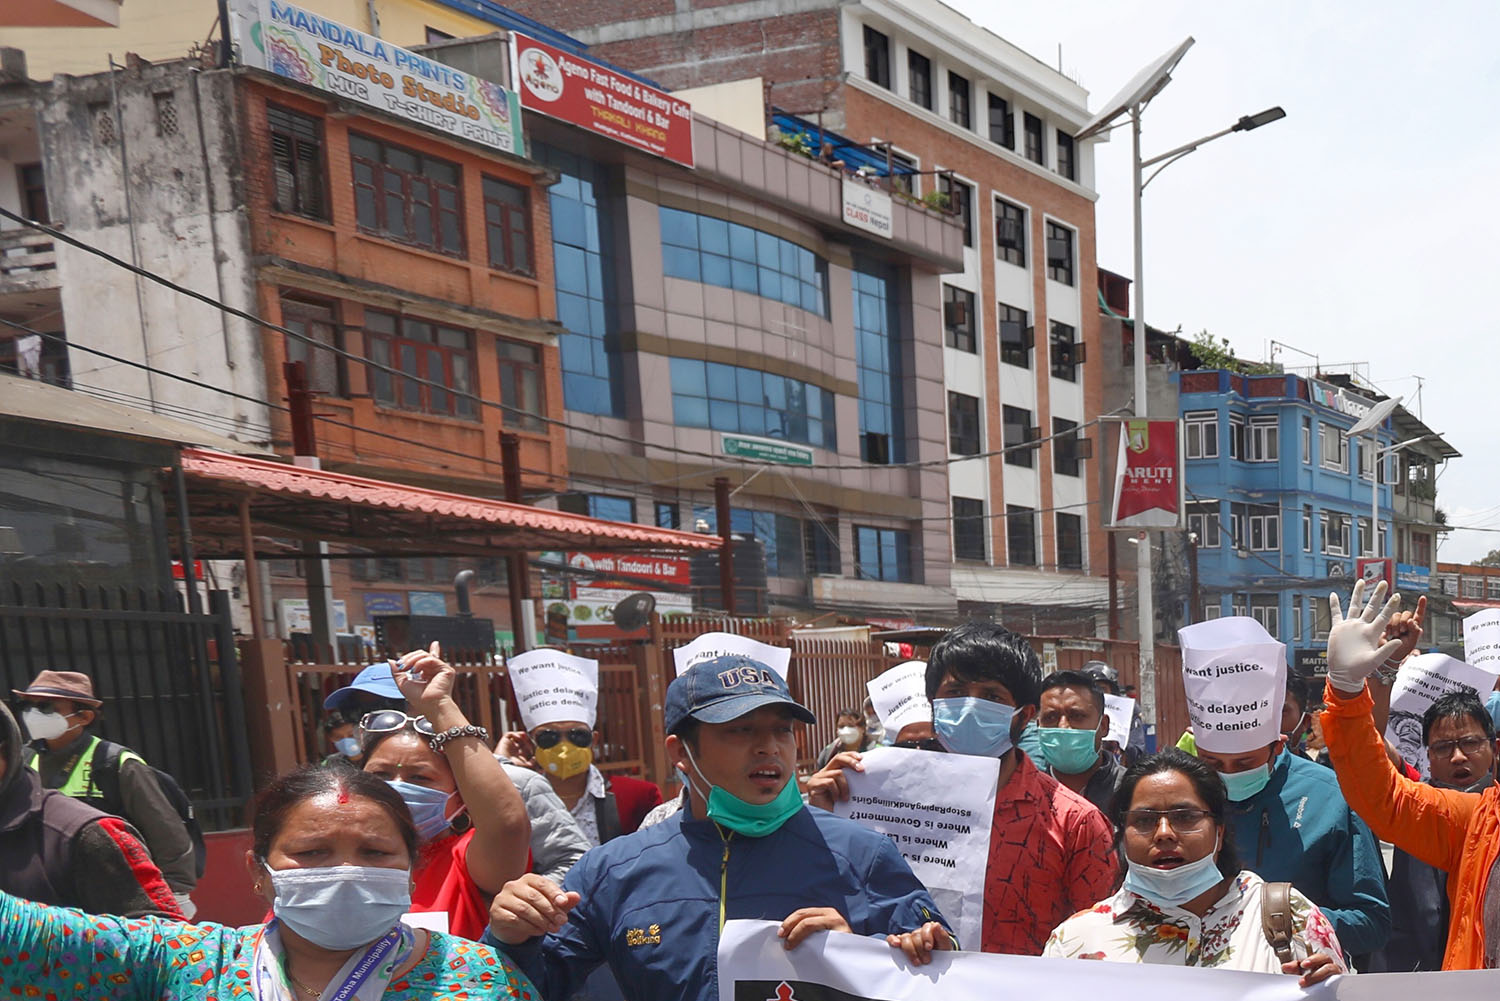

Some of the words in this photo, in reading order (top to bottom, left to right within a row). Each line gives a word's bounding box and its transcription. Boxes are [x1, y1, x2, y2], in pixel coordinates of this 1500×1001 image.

[270, 1, 390, 62] MANDALA
[395, 49, 466, 91] PRINTS
[317, 43, 394, 89] Photo
[401, 76, 480, 120] Studio
[558, 56, 589, 80] Ageno
[590, 68, 609, 88] Fast
[610, 77, 632, 95] Food
[634, 86, 641, 100] &
[642, 90, 671, 115] Bakery
[672, 103, 691, 120] Cafe
[327, 72, 369, 101] MUG
[384, 93, 455, 131] T-SHIRT
[462, 121, 512, 149] PRINT
[584, 86, 606, 106] with
[607, 94, 646, 122] Tandoori
[647, 110, 654, 123] &
[655, 112, 670, 130] Bar
[1125, 467, 1173, 478] ARUTI
[594, 559, 614, 571] with
[617, 559, 653, 575] Tandoori
[655, 563, 661, 574] &
[662, 564, 677, 576] Bar
[518, 666, 529, 675] We
[531, 662, 555, 670] want
[1216, 662, 1263, 678] justice.
[718, 667, 780, 690] USA
[1207, 700, 1258, 715] delayed
[1260, 699, 1269, 708] is
[1216, 718, 1261, 731] denied.
[852, 795, 972, 817] #StopRapingAndKillingGirls
[850, 811, 921, 828] Government?
[924, 820, 934, 830] is
[936, 822, 971, 834] Where
[902, 835, 912, 844] is
[914, 836, 948, 849] Where
[912, 854, 921, 864] is
[923, 855, 956, 868] Where
[333, 980, 356, 1001] Tokha
[352, 938, 391, 980] Municipality
